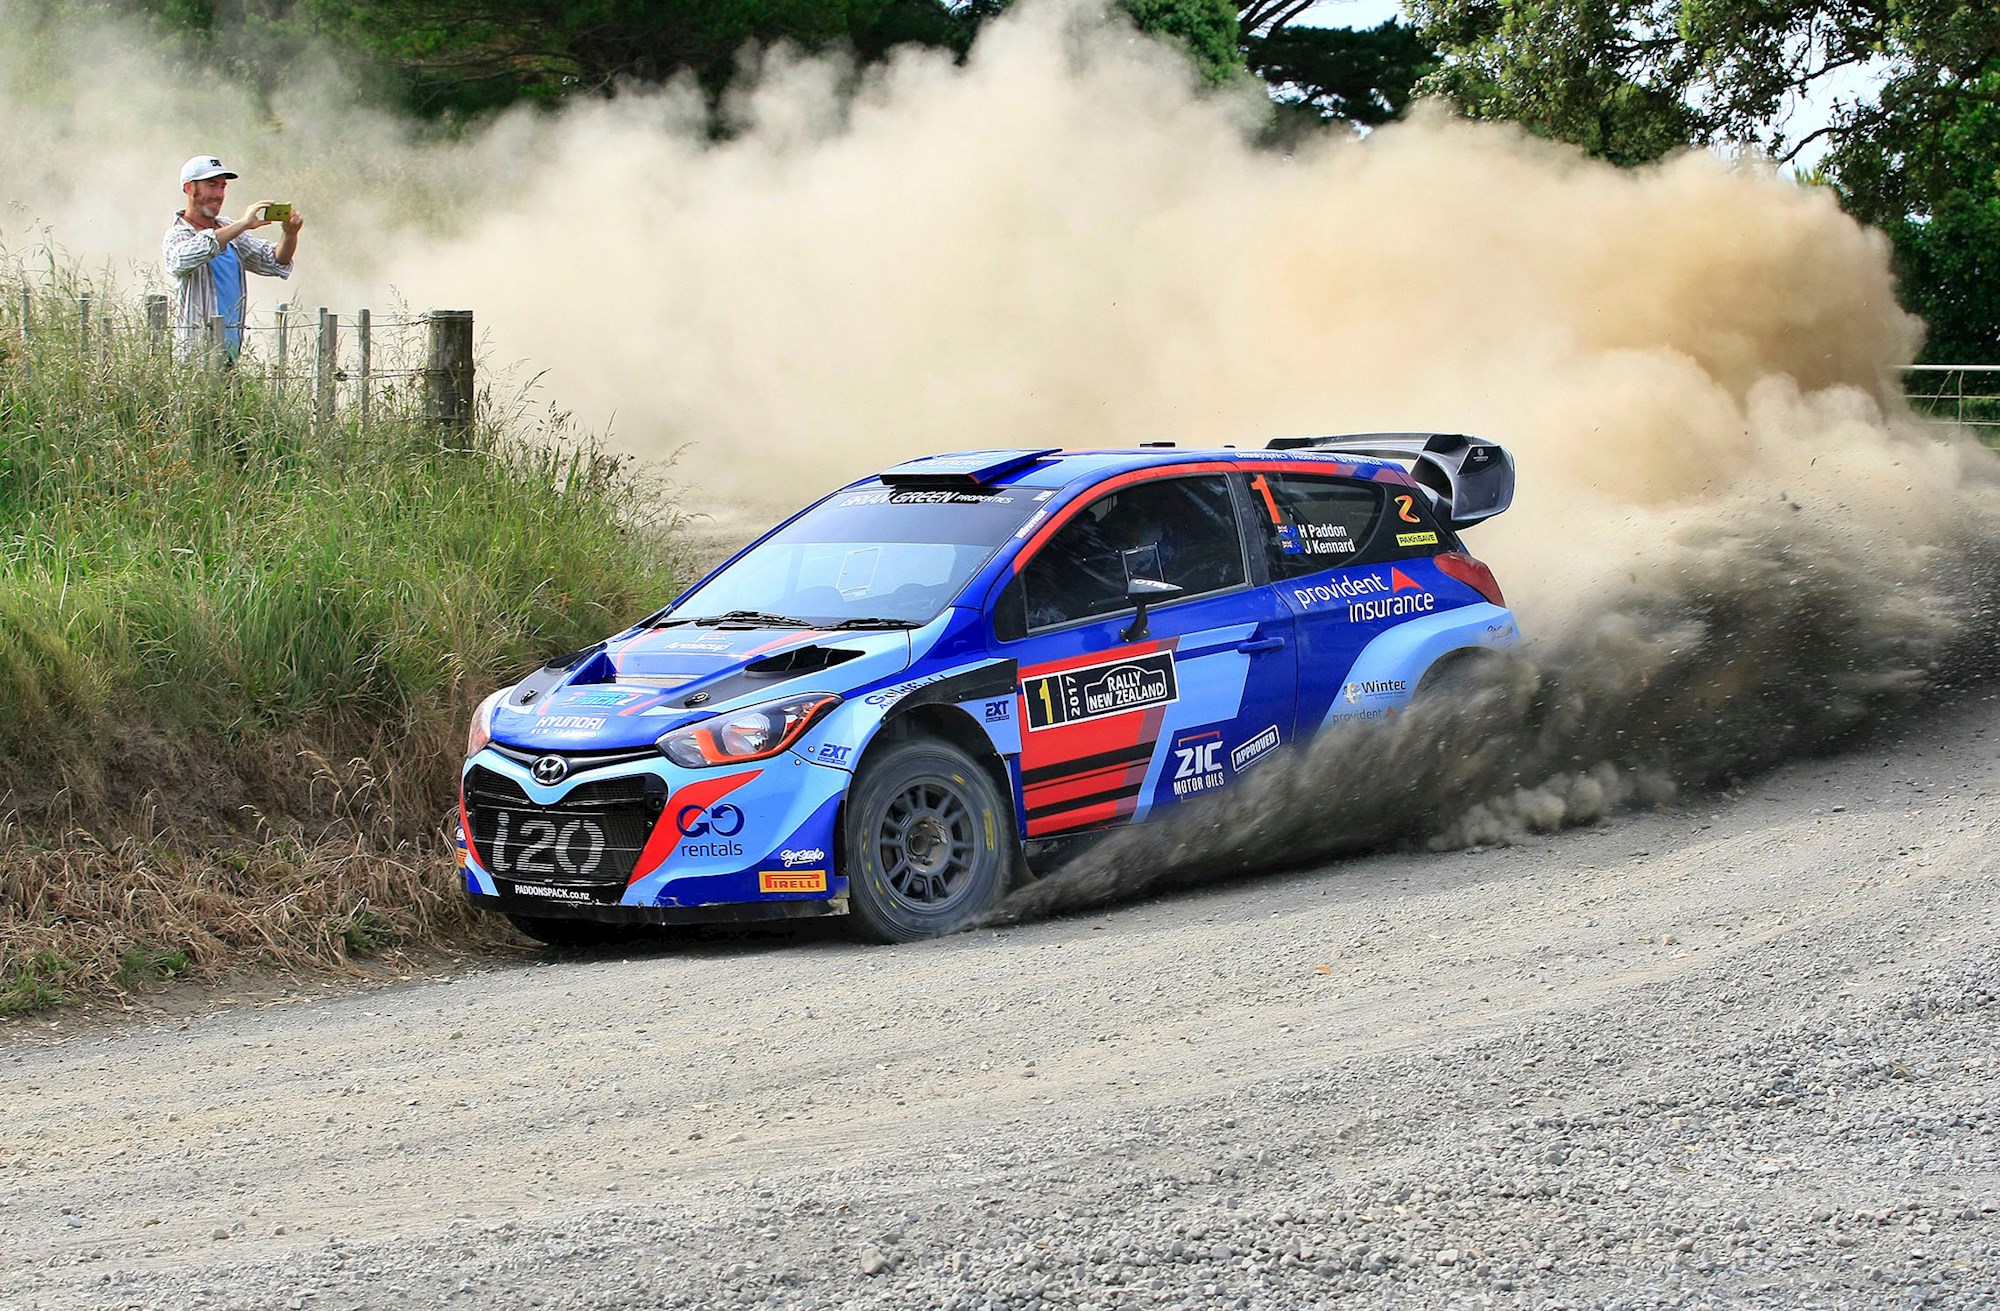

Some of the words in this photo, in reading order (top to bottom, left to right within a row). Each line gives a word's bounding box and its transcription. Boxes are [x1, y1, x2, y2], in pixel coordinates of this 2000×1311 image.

[893, 490, 961, 504] GREEN
[1251, 474, 1282, 524] 1
[1298, 524, 1308, 539] H
[1309, 523, 1347, 539] Paddon
[1304, 540, 1312, 555] J
[1313, 539, 1356, 554] Kennard
[1293, 573, 1390, 610] provident
[1346, 592, 1435, 624] insurance
[1106, 670, 1142, 692] RALLY
[1361, 679, 1406, 694] Wintec
[1039, 678, 1053, 724] 1
[1066, 675, 1081, 717] 2017
[1088, 691, 1114, 711] NEW
[1115, 681, 1164, 705] ZEALAND
[534, 716, 608, 730] HYUNDAI
[1332, 708, 1383, 726] provident
[1235, 731, 1276, 766] APPROVED
[1174, 741, 1224, 779] ZIC
[1173, 776, 1204, 796] MOTOR
[1205, 772, 1225, 789] OILS
[681, 840, 744, 857] rentals
[514, 884, 591, 900] PADDONSPACK.co.nz
[765, 874, 820, 889] PIRELLI
